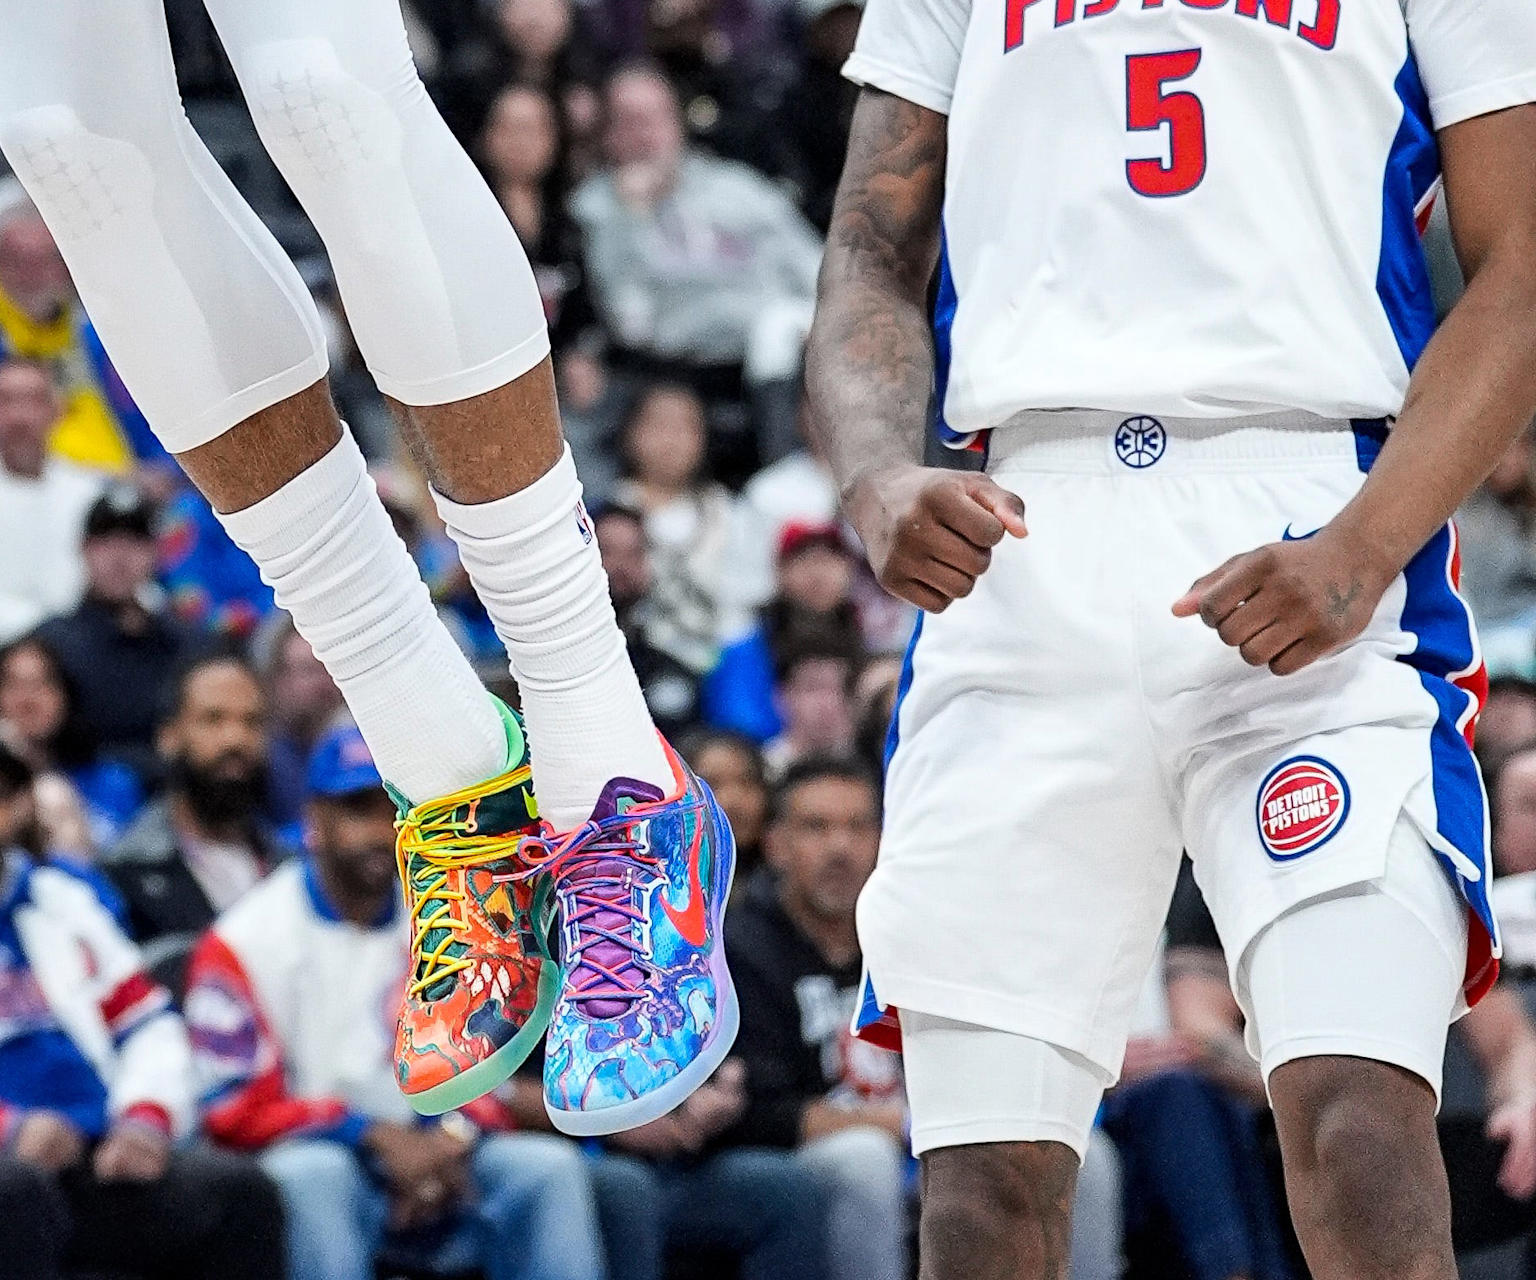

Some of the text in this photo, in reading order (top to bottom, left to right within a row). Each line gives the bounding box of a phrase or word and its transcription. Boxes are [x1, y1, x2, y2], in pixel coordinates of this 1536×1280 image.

[1125, 47, 1207, 199] 5
[1266, 782, 1327, 817] DETROIT
[1268, 799, 1330, 835] PISTONS
